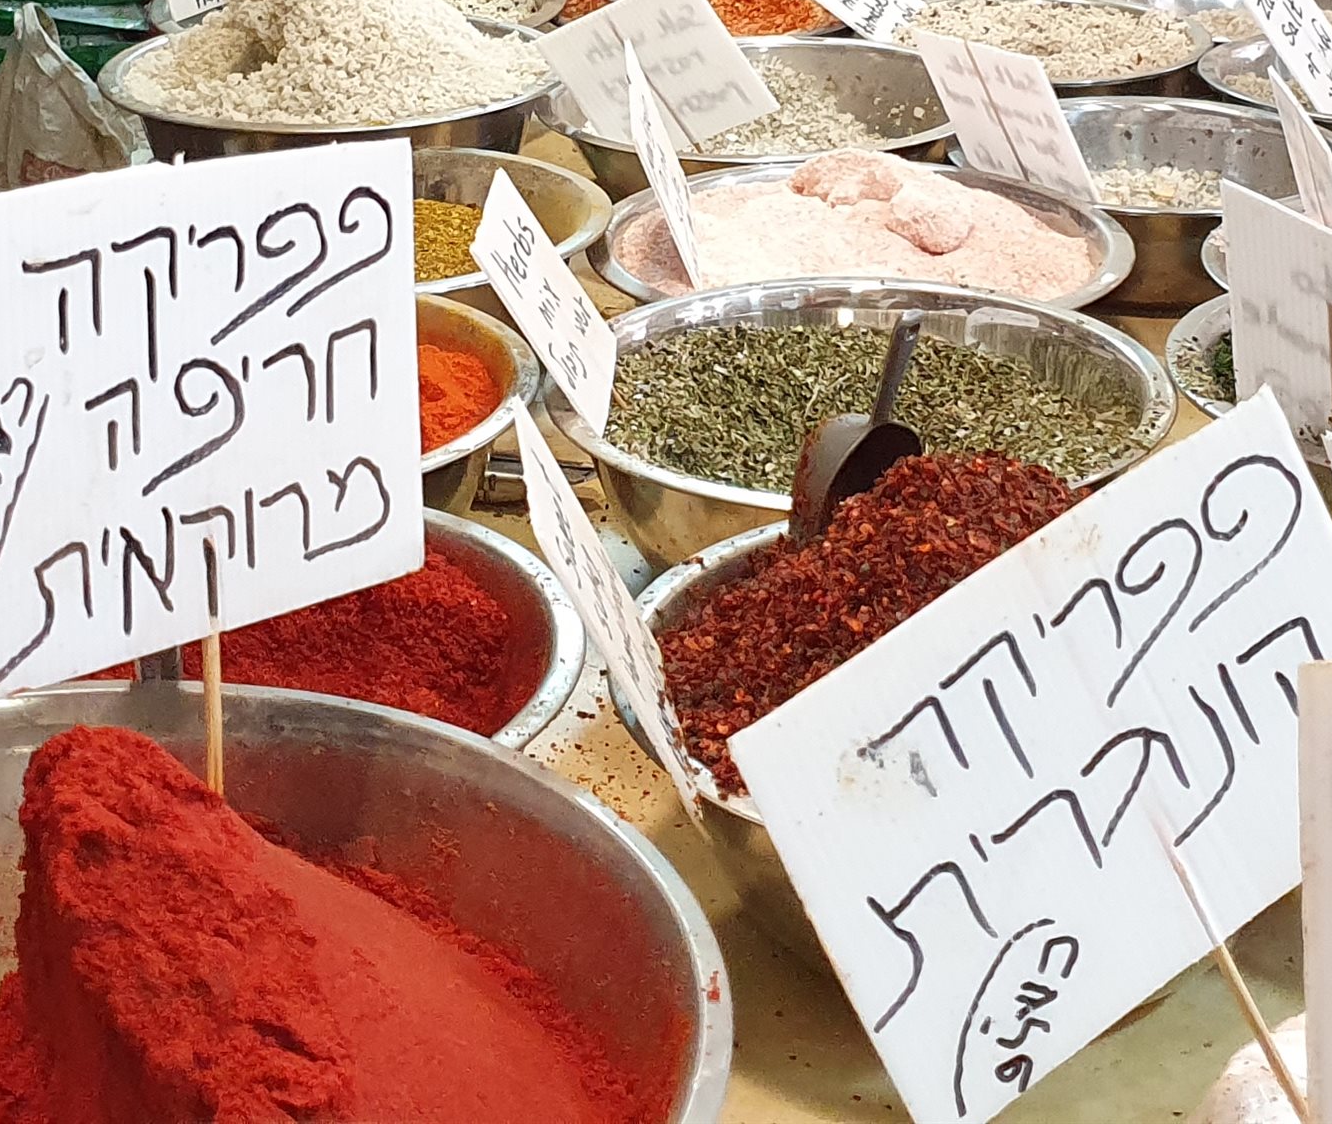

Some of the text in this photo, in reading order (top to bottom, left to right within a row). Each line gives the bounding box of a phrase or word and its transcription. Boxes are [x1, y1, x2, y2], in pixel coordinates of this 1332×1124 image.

[22, 185, 393, 383] פפריקה
[491, 216, 536, 300] Herbs
[85, 317, 378, 497] חריפה
[856, 454, 1303, 799] פפריקה
[867, 616, 1324, 1034] הונגרית
